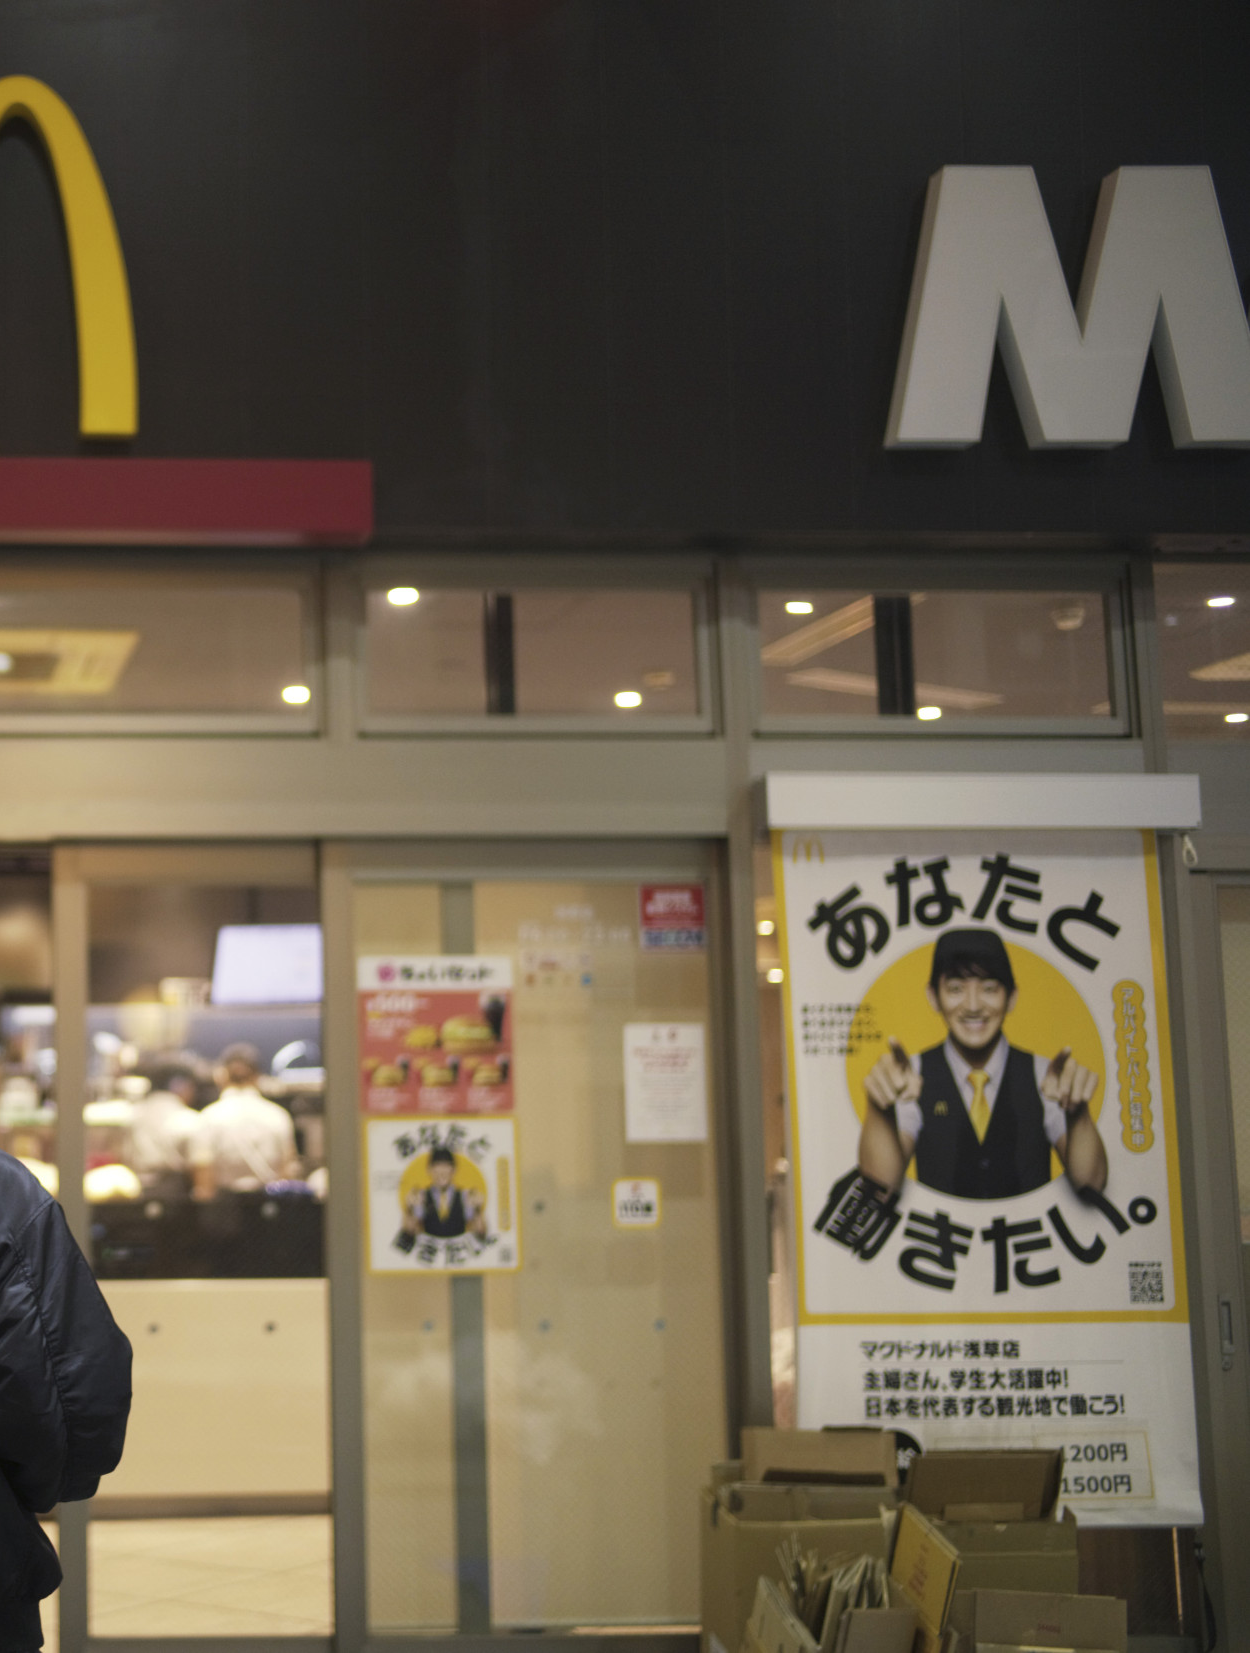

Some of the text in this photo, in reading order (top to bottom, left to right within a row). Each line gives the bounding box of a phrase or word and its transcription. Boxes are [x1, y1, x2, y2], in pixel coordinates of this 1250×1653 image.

[883, 164, 1250, 449] M
[807, 853, 1121, 973] あなたと
[860, 1340, 1020, 1359] マクドナルド浅草店
[1061, 1474, 1132, 1495] 1500円
